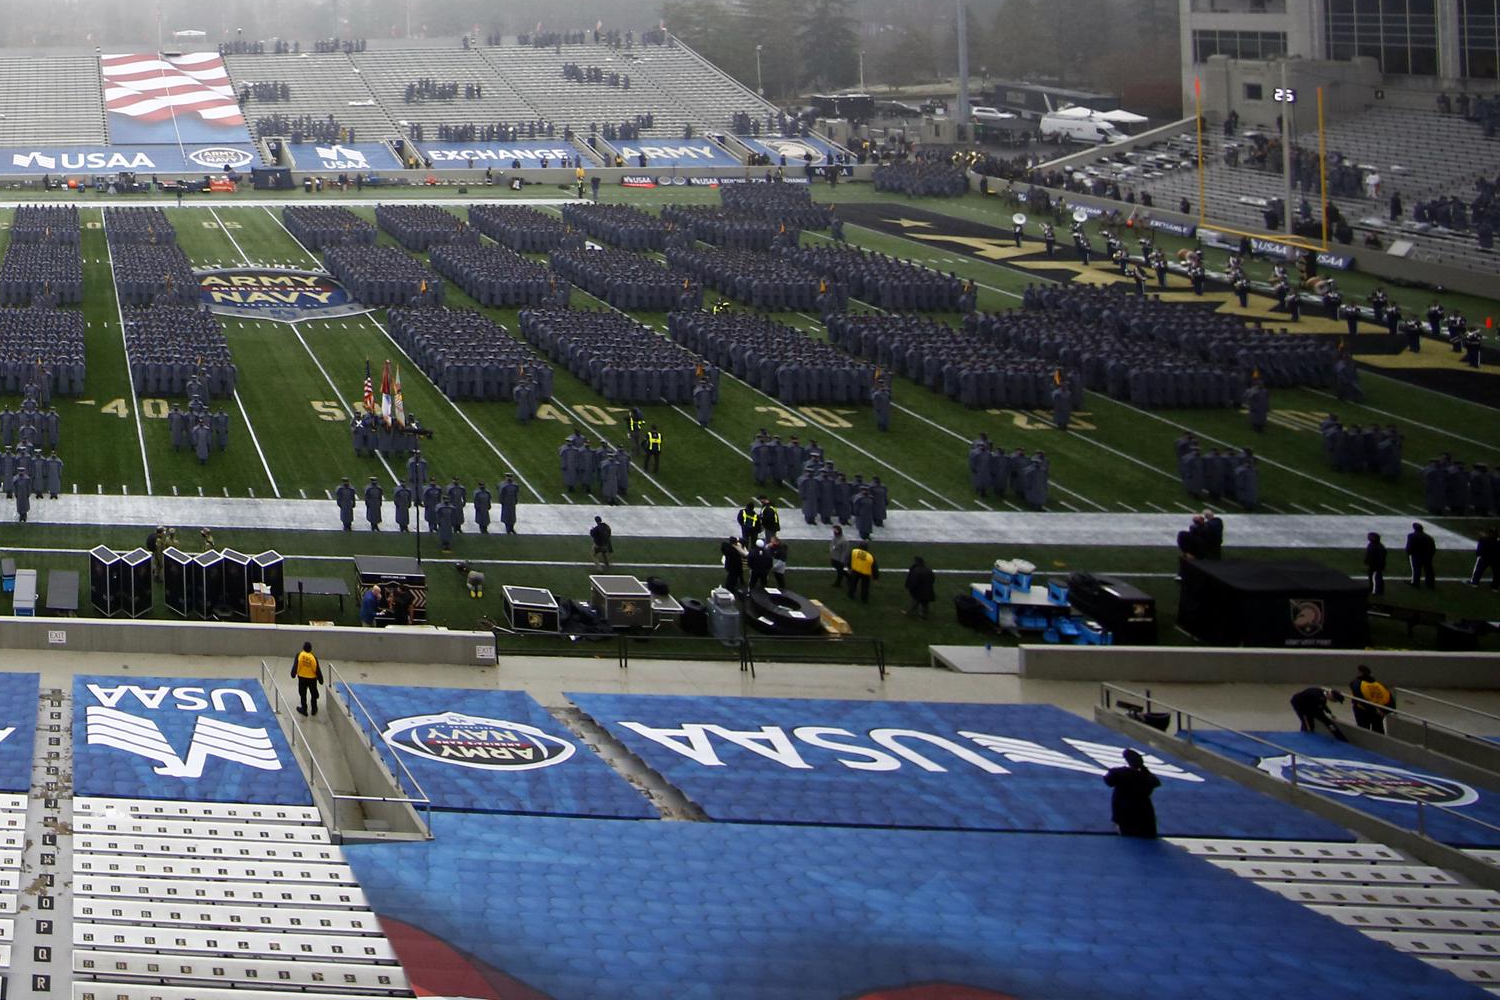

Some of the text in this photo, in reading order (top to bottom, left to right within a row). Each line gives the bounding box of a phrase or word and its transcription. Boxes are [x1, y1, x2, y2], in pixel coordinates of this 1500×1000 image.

[428, 149, 568, 161] EXCHANGE
[622, 146, 714, 160] ARMY
[61, 153, 155, 168] USAA
[323, 160, 370, 169] USAA
[632, 176, 651, 184] USAA
[700, 177, 719, 185] USAA
[1258, 241, 1288, 255] USAA
[201, 276, 319, 287] ARMY
[211, 291, 332, 304] NAVY
[101, 399, 169, 419] 40
[536, 404, 617, 426] 40
[86, 684, 258, 712] USAA
[428, 728, 518, 741] NAVY
[441, 745, 534, 760] ARMY
[617, 721, 1012, 775] USAA
